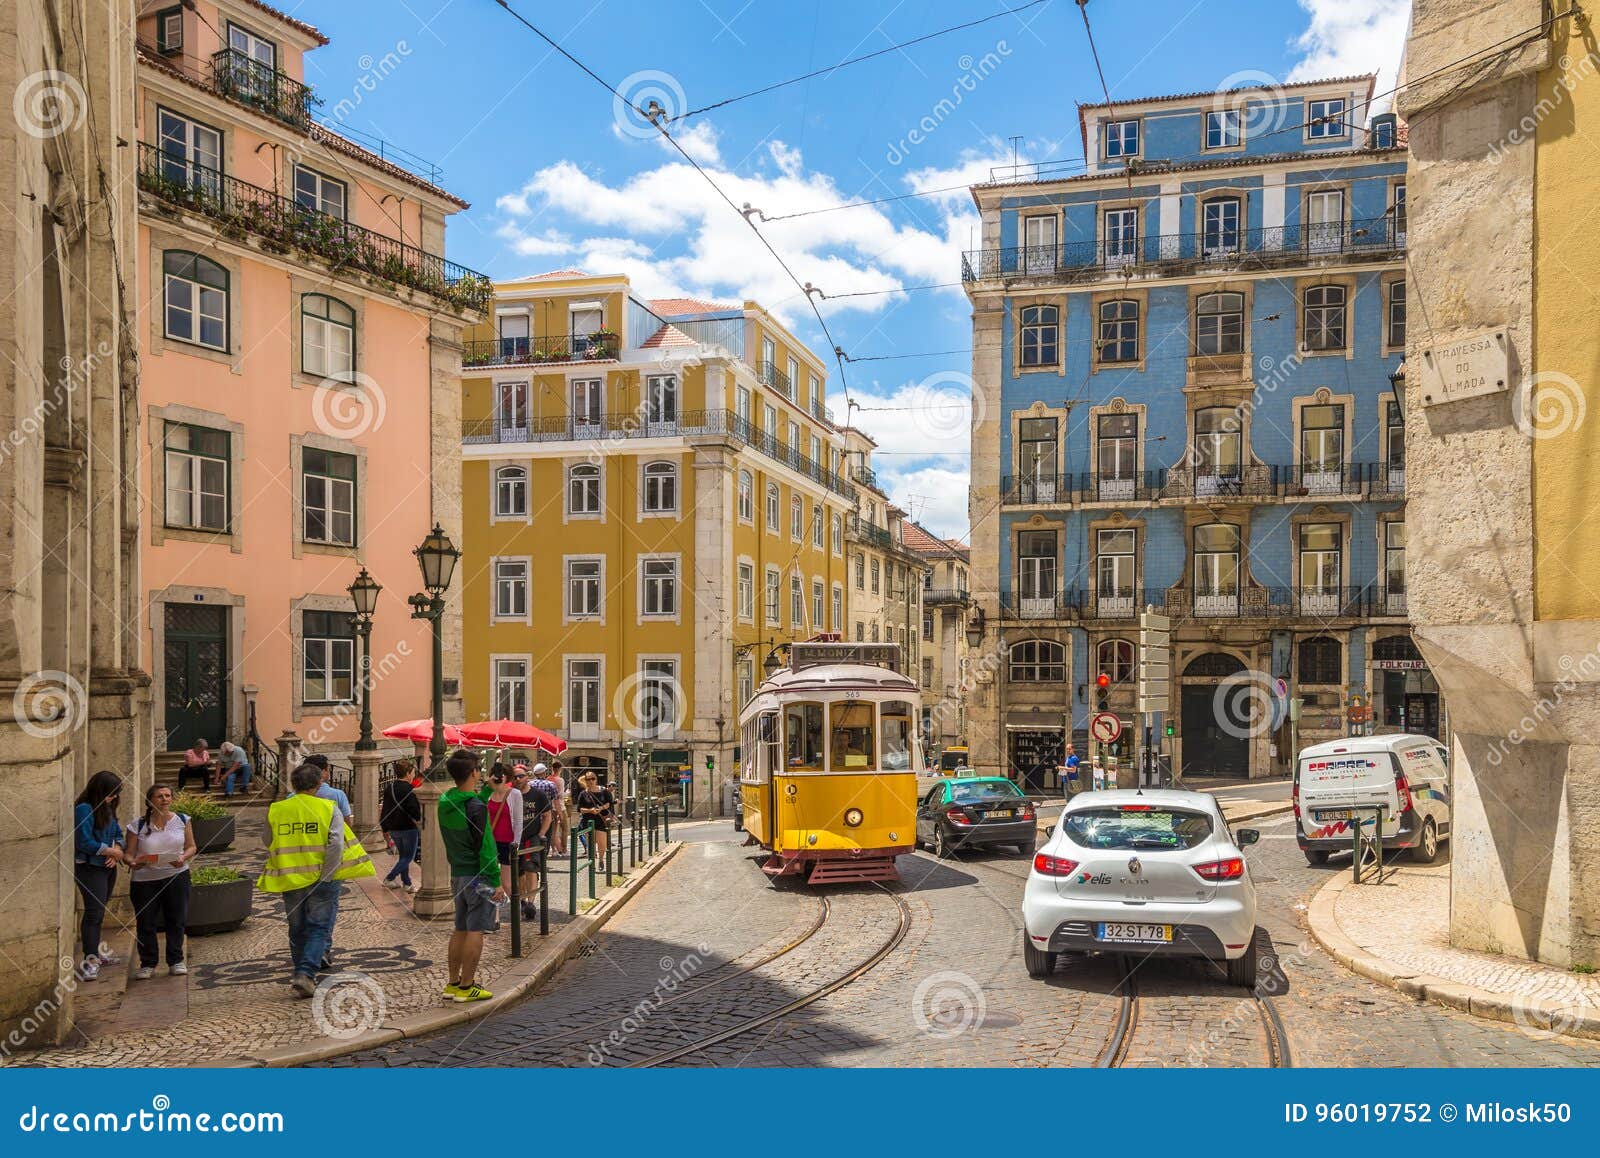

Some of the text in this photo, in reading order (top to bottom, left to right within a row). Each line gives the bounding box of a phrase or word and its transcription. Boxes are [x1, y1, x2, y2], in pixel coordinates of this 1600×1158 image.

[1437, 340, 1490, 359] TRAVESSA
[1443, 377, 1485, 392] ALMADA
[1380, 661, 1402, 669] FOLK
[1090, 873, 1112, 885] elis
